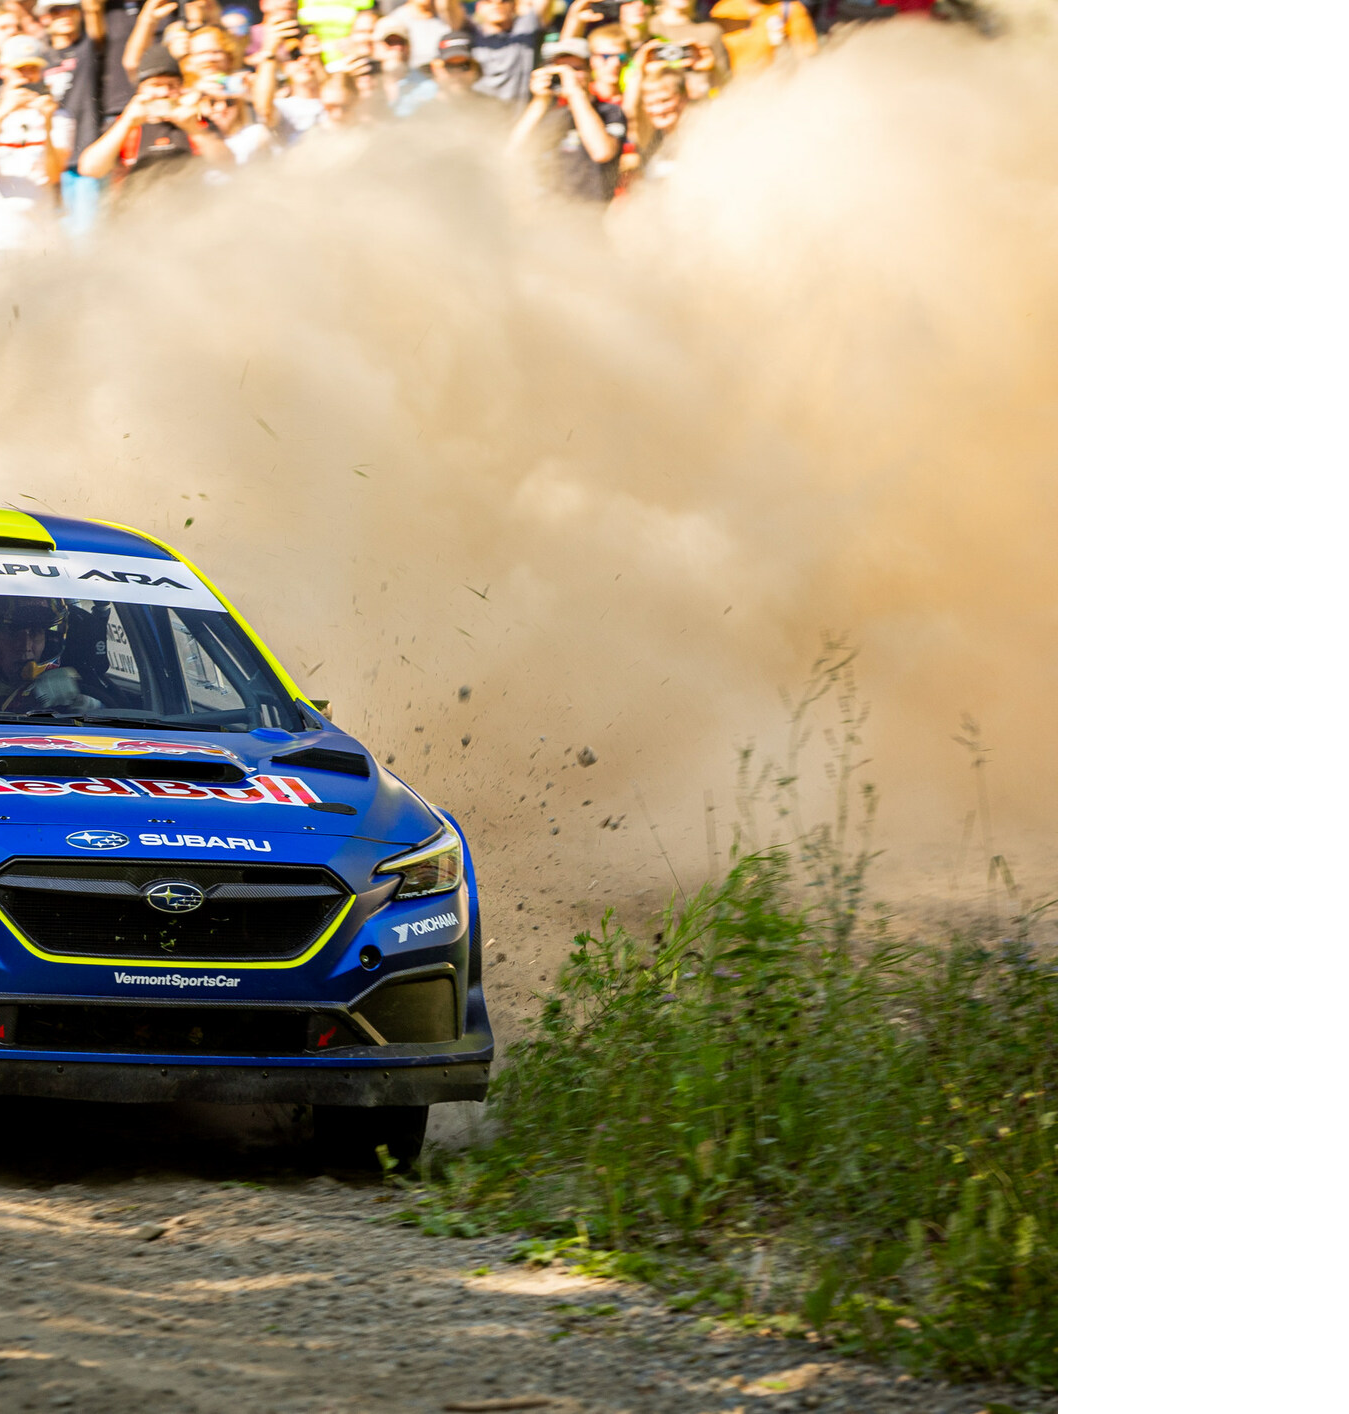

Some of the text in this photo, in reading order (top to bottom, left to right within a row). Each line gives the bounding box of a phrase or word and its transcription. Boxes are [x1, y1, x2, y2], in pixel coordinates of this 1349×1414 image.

[77, 569, 194, 591] ARA
[127, 774, 323, 807] Bull
[140, 833, 272, 852] SUBARU
[408, 912, 460, 937] YOKOHAMA
[113, 971, 241, 989] VermontSportsCar
